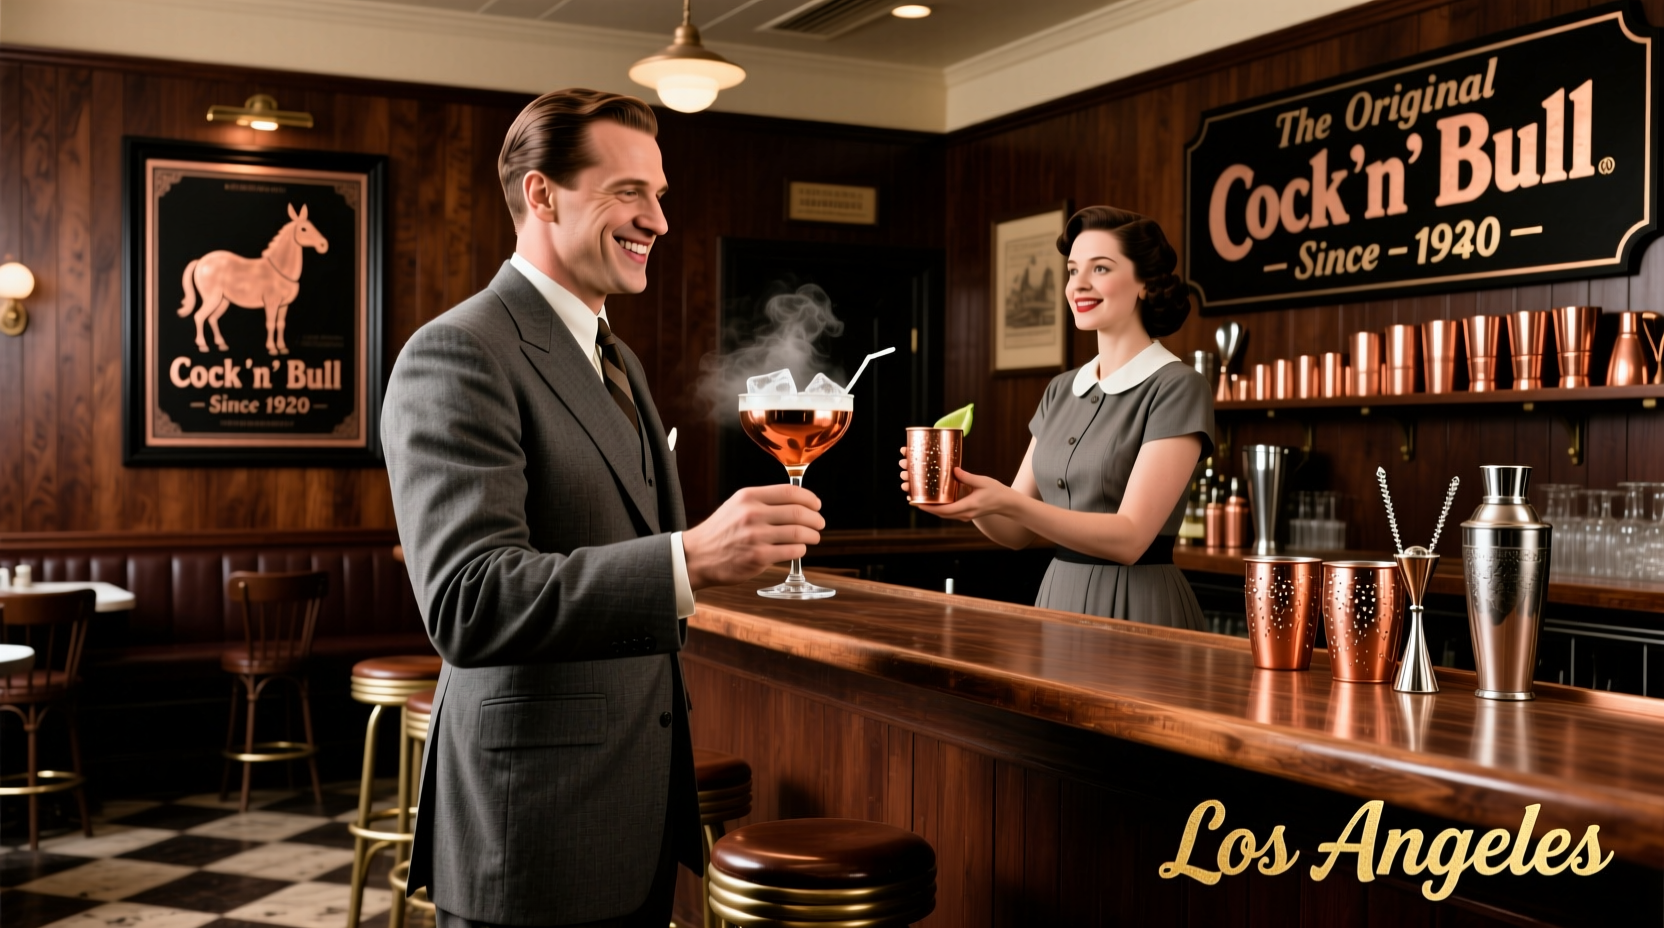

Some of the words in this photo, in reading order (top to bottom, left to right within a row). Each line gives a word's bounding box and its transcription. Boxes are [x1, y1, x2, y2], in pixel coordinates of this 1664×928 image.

[1276, 107, 1332, 148] The
[1345, 56, 1498, 130] Original
[1434, 78, 1596, 208] Bull
[1294, 240, 1381, 280] Since
[169, 355, 243, 389] Cock
[286, 359, 341, 390] Bull
[208, 394, 260, 414] Since
[266, 395, 311, 414] 1920
